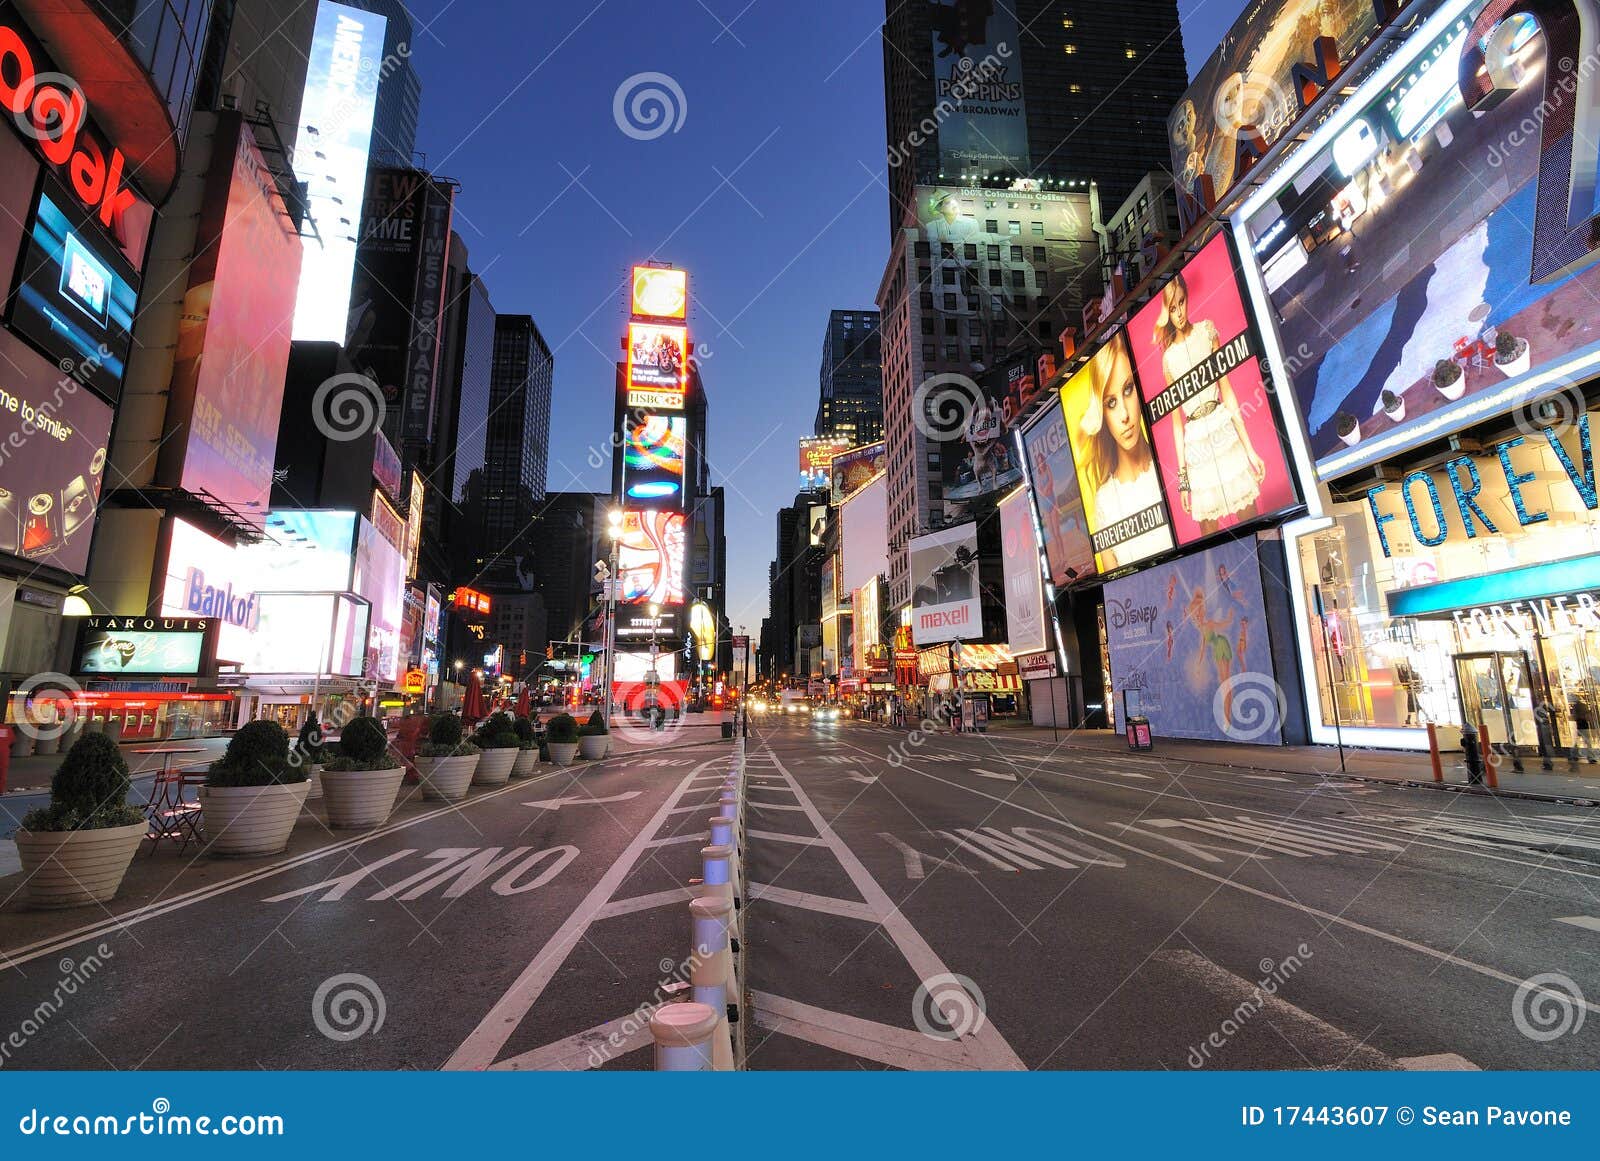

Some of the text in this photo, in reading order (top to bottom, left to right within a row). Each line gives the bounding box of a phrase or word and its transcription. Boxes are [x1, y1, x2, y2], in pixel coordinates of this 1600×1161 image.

[951, 63, 1008, 84] MARY
[939, 79, 1021, 103] POPPINS
[962, 105, 1020, 117] BROADWAY
[374, 174, 419, 199] EW
[984, 189, 1034, 200] Colombian
[1035, 192, 1066, 202] Coffee
[363, 217, 414, 240] AME
[424, 205, 446, 289] TIMES
[411, 300, 437, 410] SQUARE
[1150, 336, 1250, 418] FOREVER21.COM
[21, 400, 35, 422] to
[630, 393, 664, 405] HSBC
[1093, 504, 1163, 551] FOREVER21.COM
[183, 566, 257, 630] Bank of
[88, 618, 207, 630] MARQUIS
[920, 605, 969, 629] maxell
[1107, 598, 1158, 633] Disney
[1452, 592, 1600, 638] FOREVER
[152, 682, 183, 693] SINATRA
[260, 844, 581, 903] ONLY
